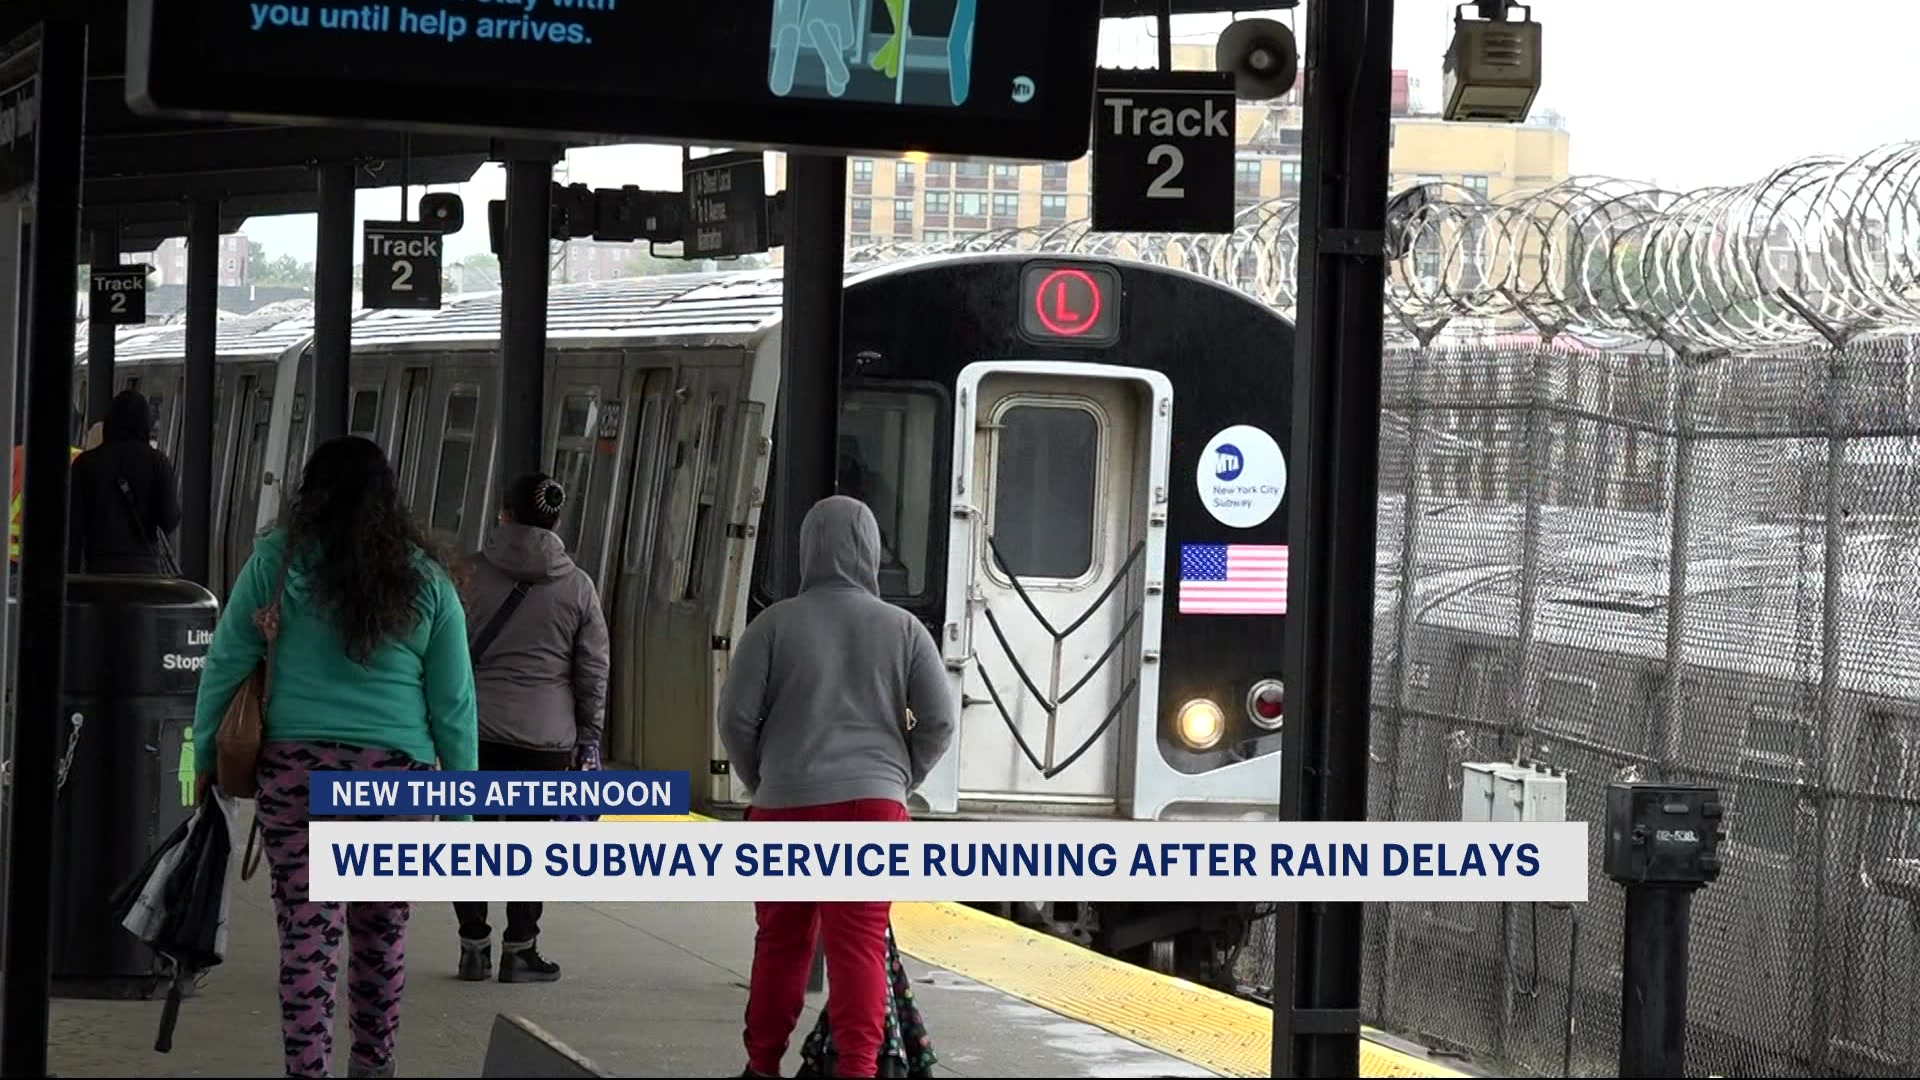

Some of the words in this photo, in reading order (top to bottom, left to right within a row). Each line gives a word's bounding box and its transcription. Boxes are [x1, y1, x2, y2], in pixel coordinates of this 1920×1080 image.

[249, 3, 310, 30] you
[319, 6, 389, 32] until
[400, 8, 467, 42] help
[475, 15, 593, 44] arrives.
[1104, 98, 1230, 138] Track
[1146, 144, 1185, 199] 2
[368, 233, 437, 258] Track
[94, 276, 143, 291] Track
[391, 260, 413, 291] 2
[111, 292, 127, 314] 2
[1056, 281, 1079, 321] L
[1213, 485, 1235, 495] New
[1236, 485, 1257, 495] York
[1260, 485, 1280, 496] City
[1213, 498, 1253, 509] Subway
